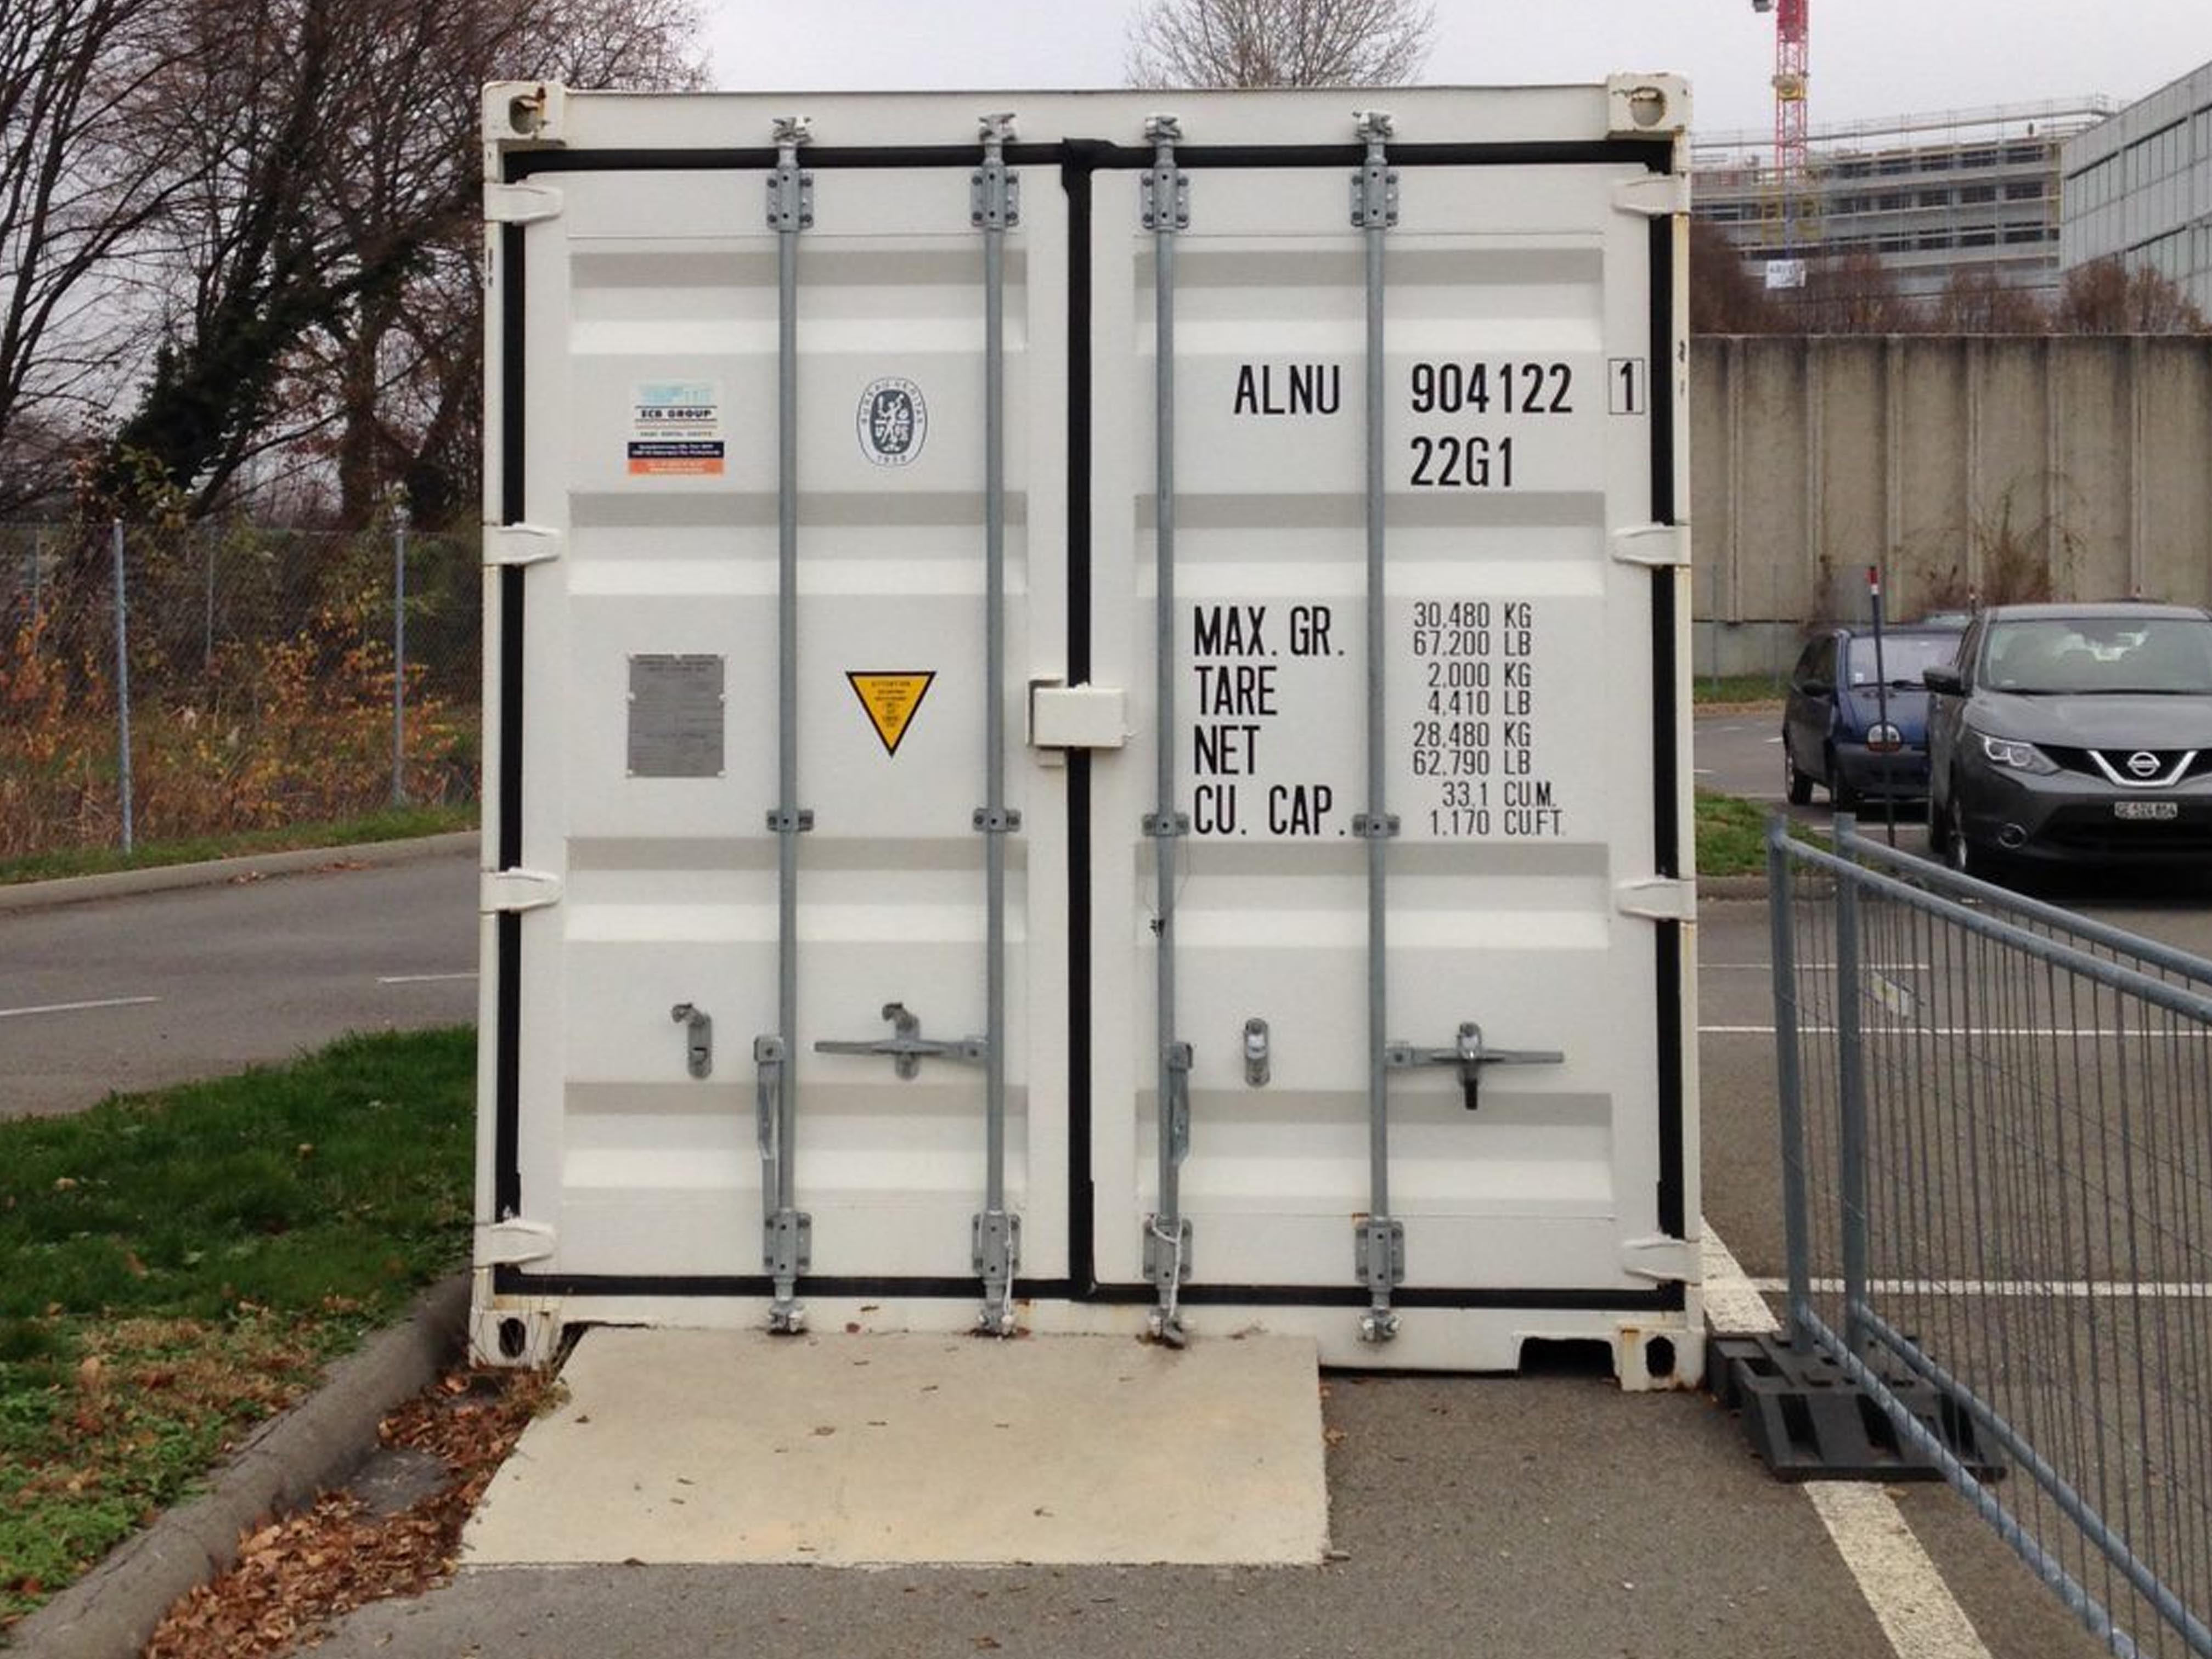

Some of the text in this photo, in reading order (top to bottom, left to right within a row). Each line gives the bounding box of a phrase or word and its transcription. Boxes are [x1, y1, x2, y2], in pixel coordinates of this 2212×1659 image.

[1234, 362, 1634, 415] ALNU 904122 1
[667, 409, 712, 417] GROUP
[1410, 436, 1513, 487] 22G1
[1414, 602, 1532, 629] 30.480 KG
[1193, 605, 1345, 657] MAX. GR.
[1414, 630, 1531, 657] 67.200 LB
[1429, 662, 1531, 688] 2.000 KG
[1193, 665, 1278, 716] TARE
[1428, 690, 1531, 716] 4.410 LB
[1414, 721, 1531, 748] 28.480 KG
[1193, 724, 1261, 775] NET
[1414, 749, 1531, 776] 62.790 LB
[1194, 785, 1346, 836] CU. CAP.
[1430, 809, 1490, 836] 1.170
